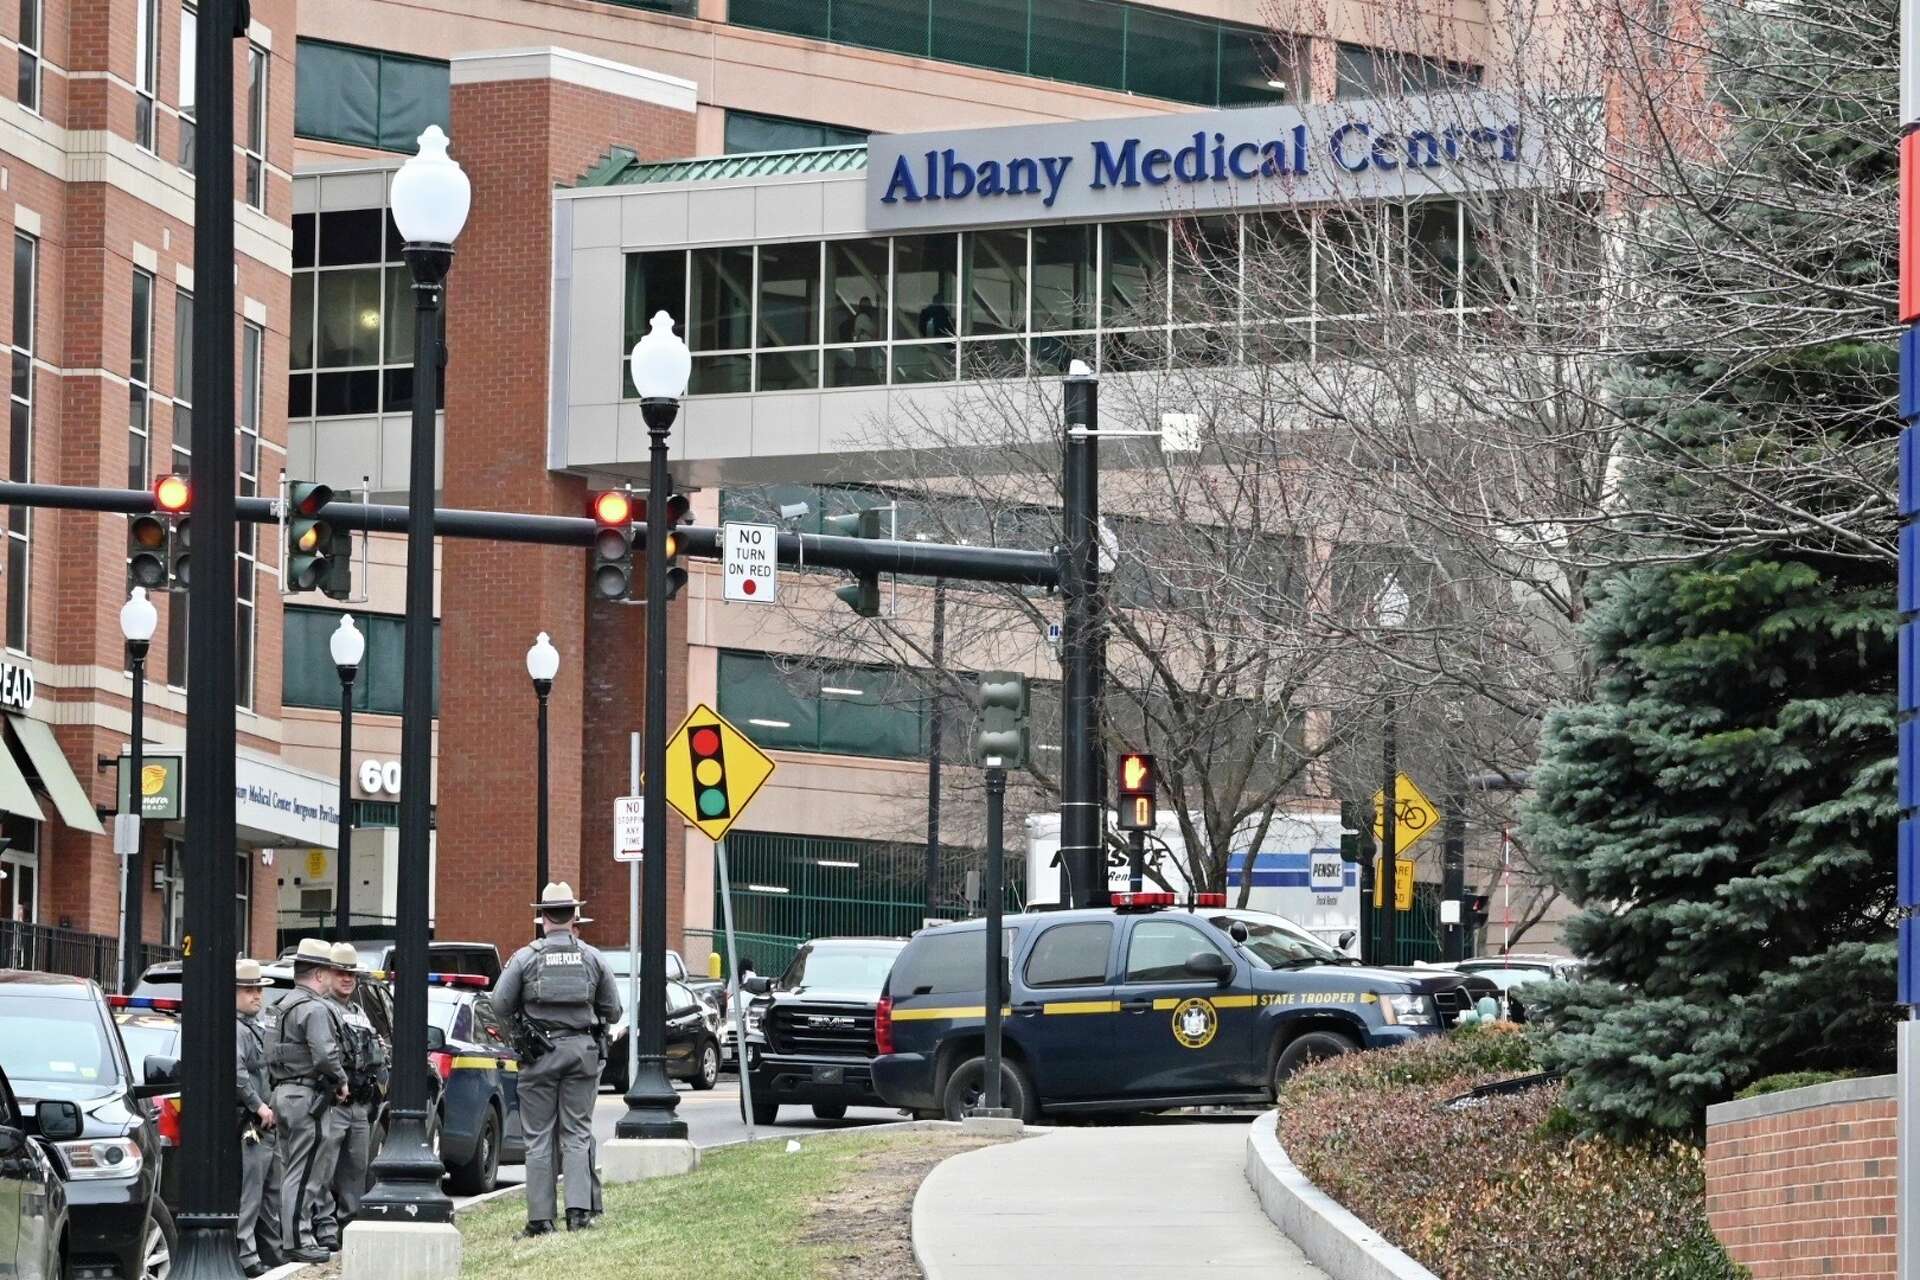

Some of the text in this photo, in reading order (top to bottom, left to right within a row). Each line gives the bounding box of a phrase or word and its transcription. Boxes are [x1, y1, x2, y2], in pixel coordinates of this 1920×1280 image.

[880, 147, 1074, 208] Albany
[1088, 122, 1309, 190] Medical
[739, 529, 762, 545] NO
[736, 547, 765, 560] TURN
[728, 562, 771, 577] ON RED
[0, 662, 34, 709] EAD
[249, 784, 272, 807] Medical
[272, 792, 292, 812] Center
[626, 801, 640, 813] NO
[1136, 798, 1148, 826] 0
[625, 827, 640, 835] ANY
[625, 837, 640, 846] TIME
[1312, 863, 1341, 878] PENSKE
[545, 952, 583, 966] STATE POLICE
[1261, 992, 1356, 1006] STATE TROOPER
